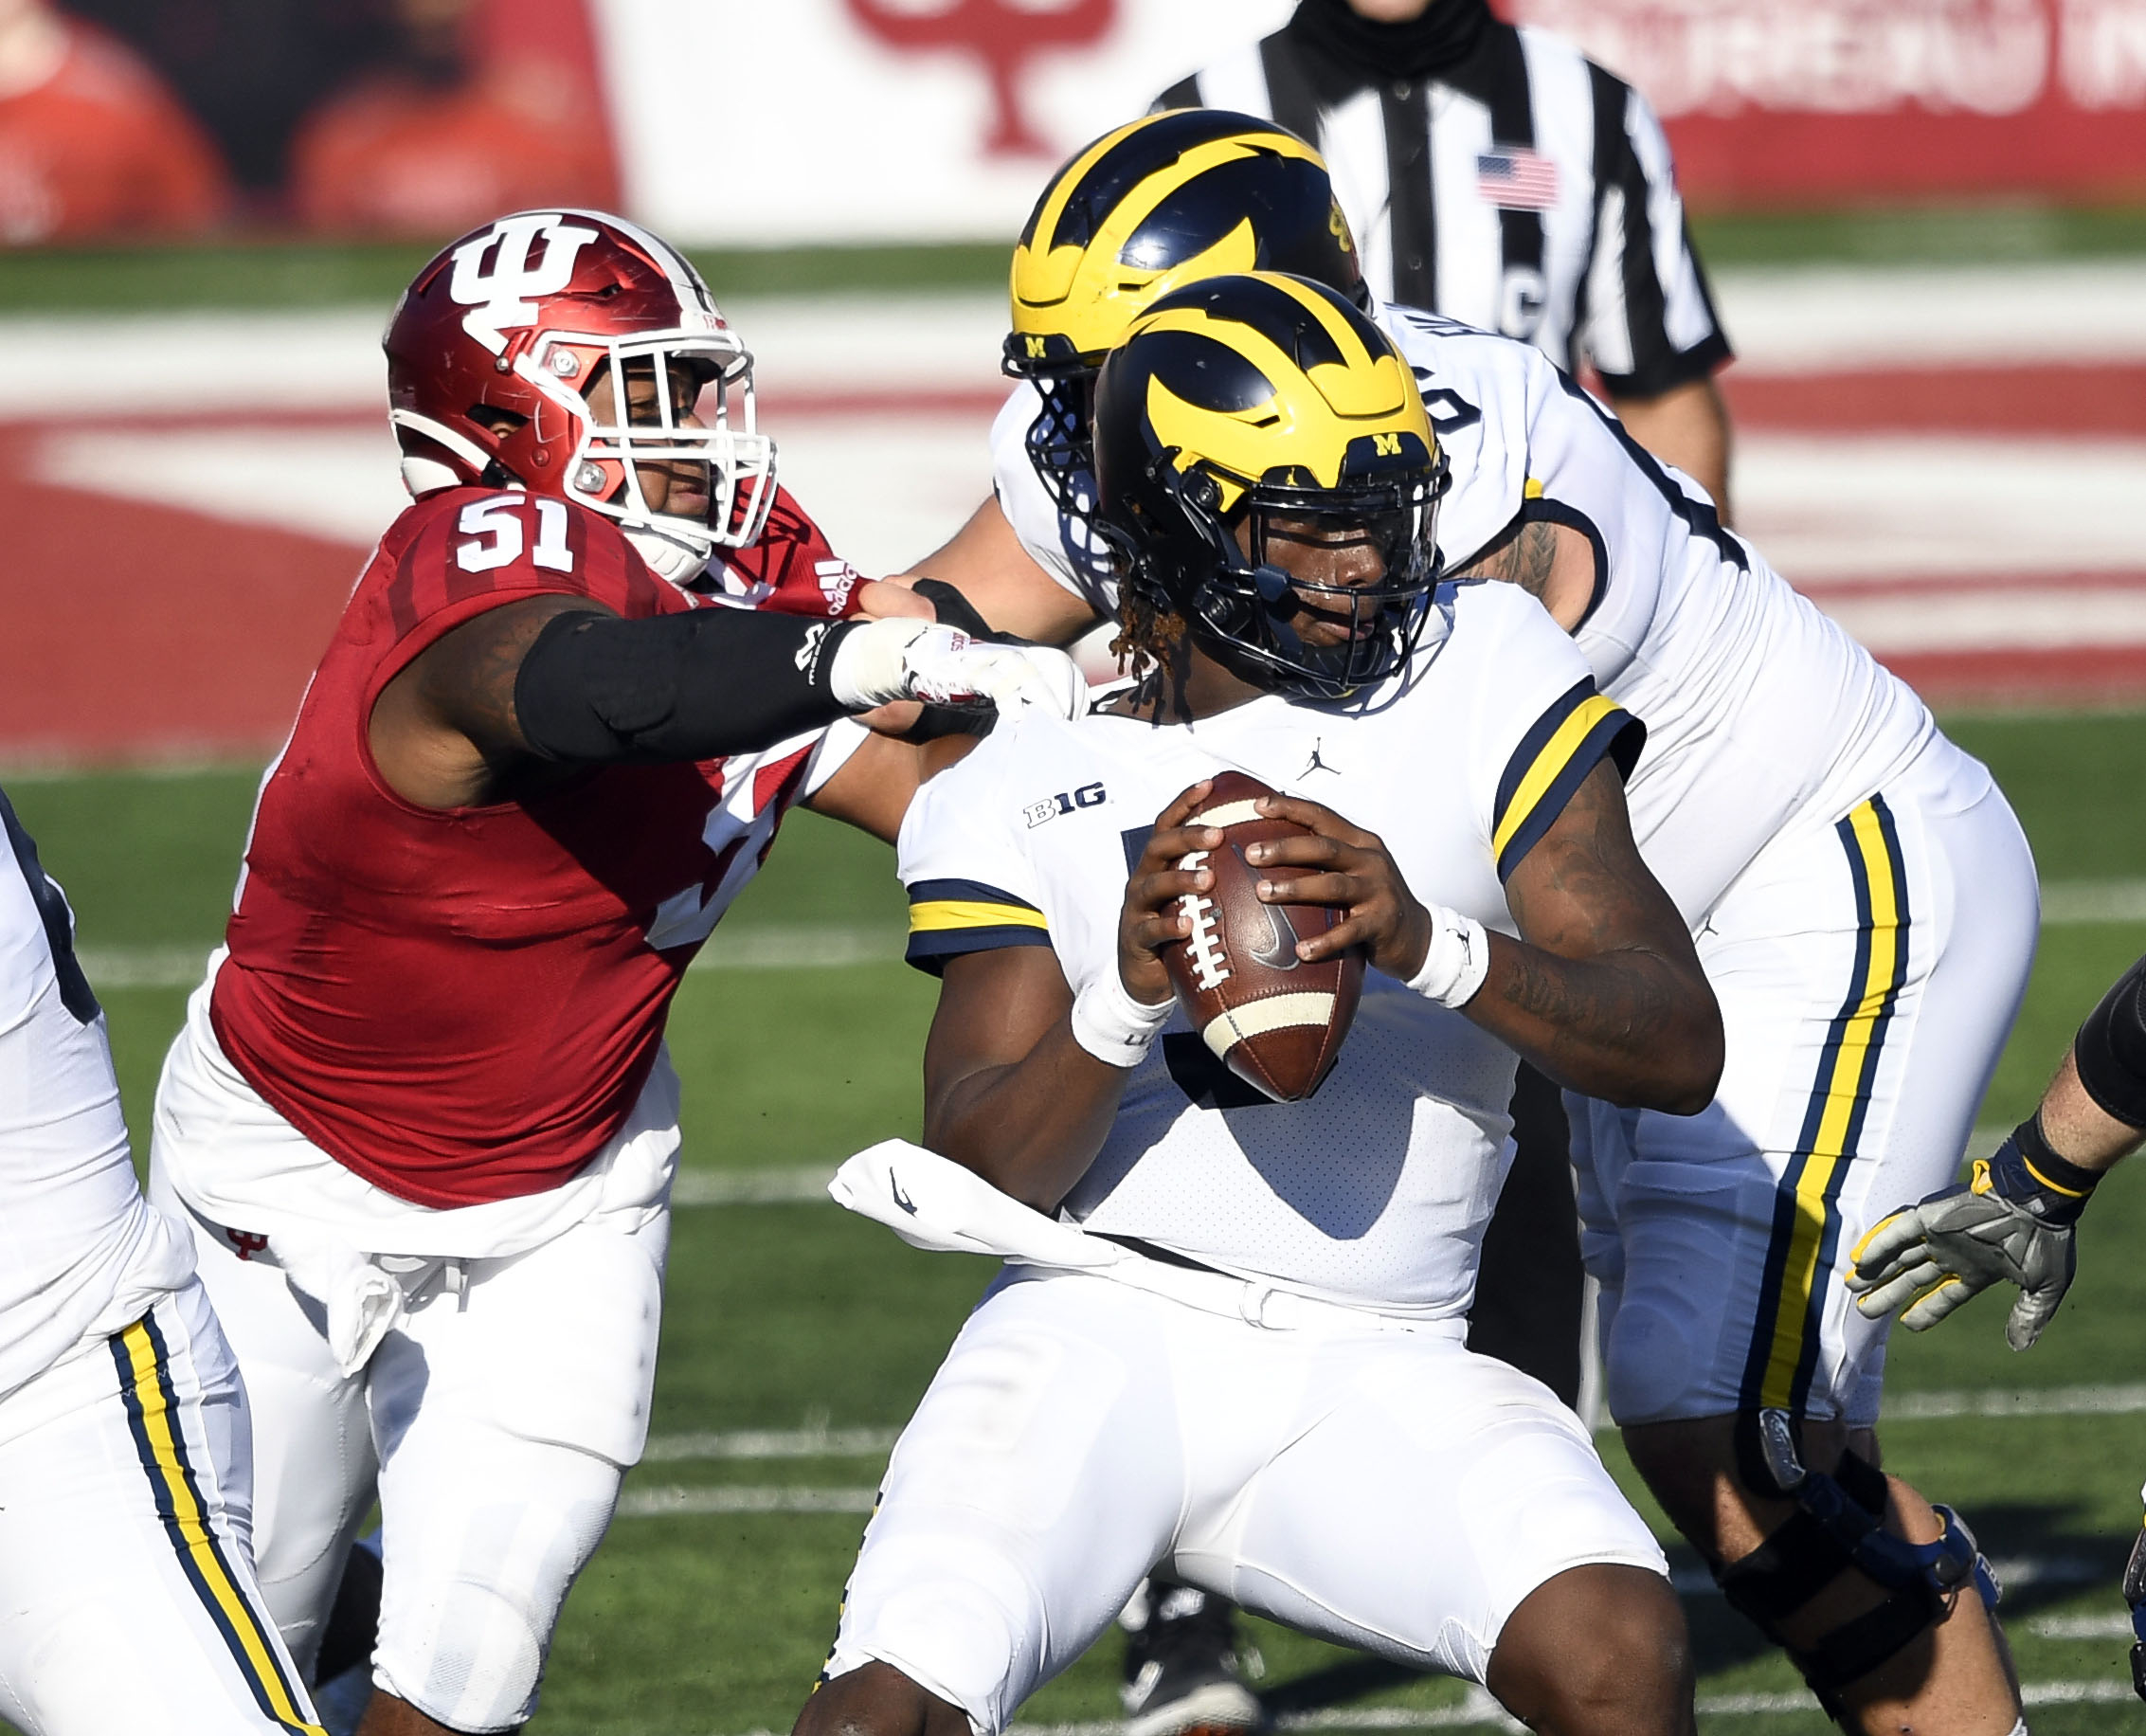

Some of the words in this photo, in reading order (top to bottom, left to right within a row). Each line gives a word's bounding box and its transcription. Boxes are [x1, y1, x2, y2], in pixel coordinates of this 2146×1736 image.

[1025, 336, 1046, 358] M
[1372, 432, 1402, 457] M
[457, 496, 573, 573] 51
